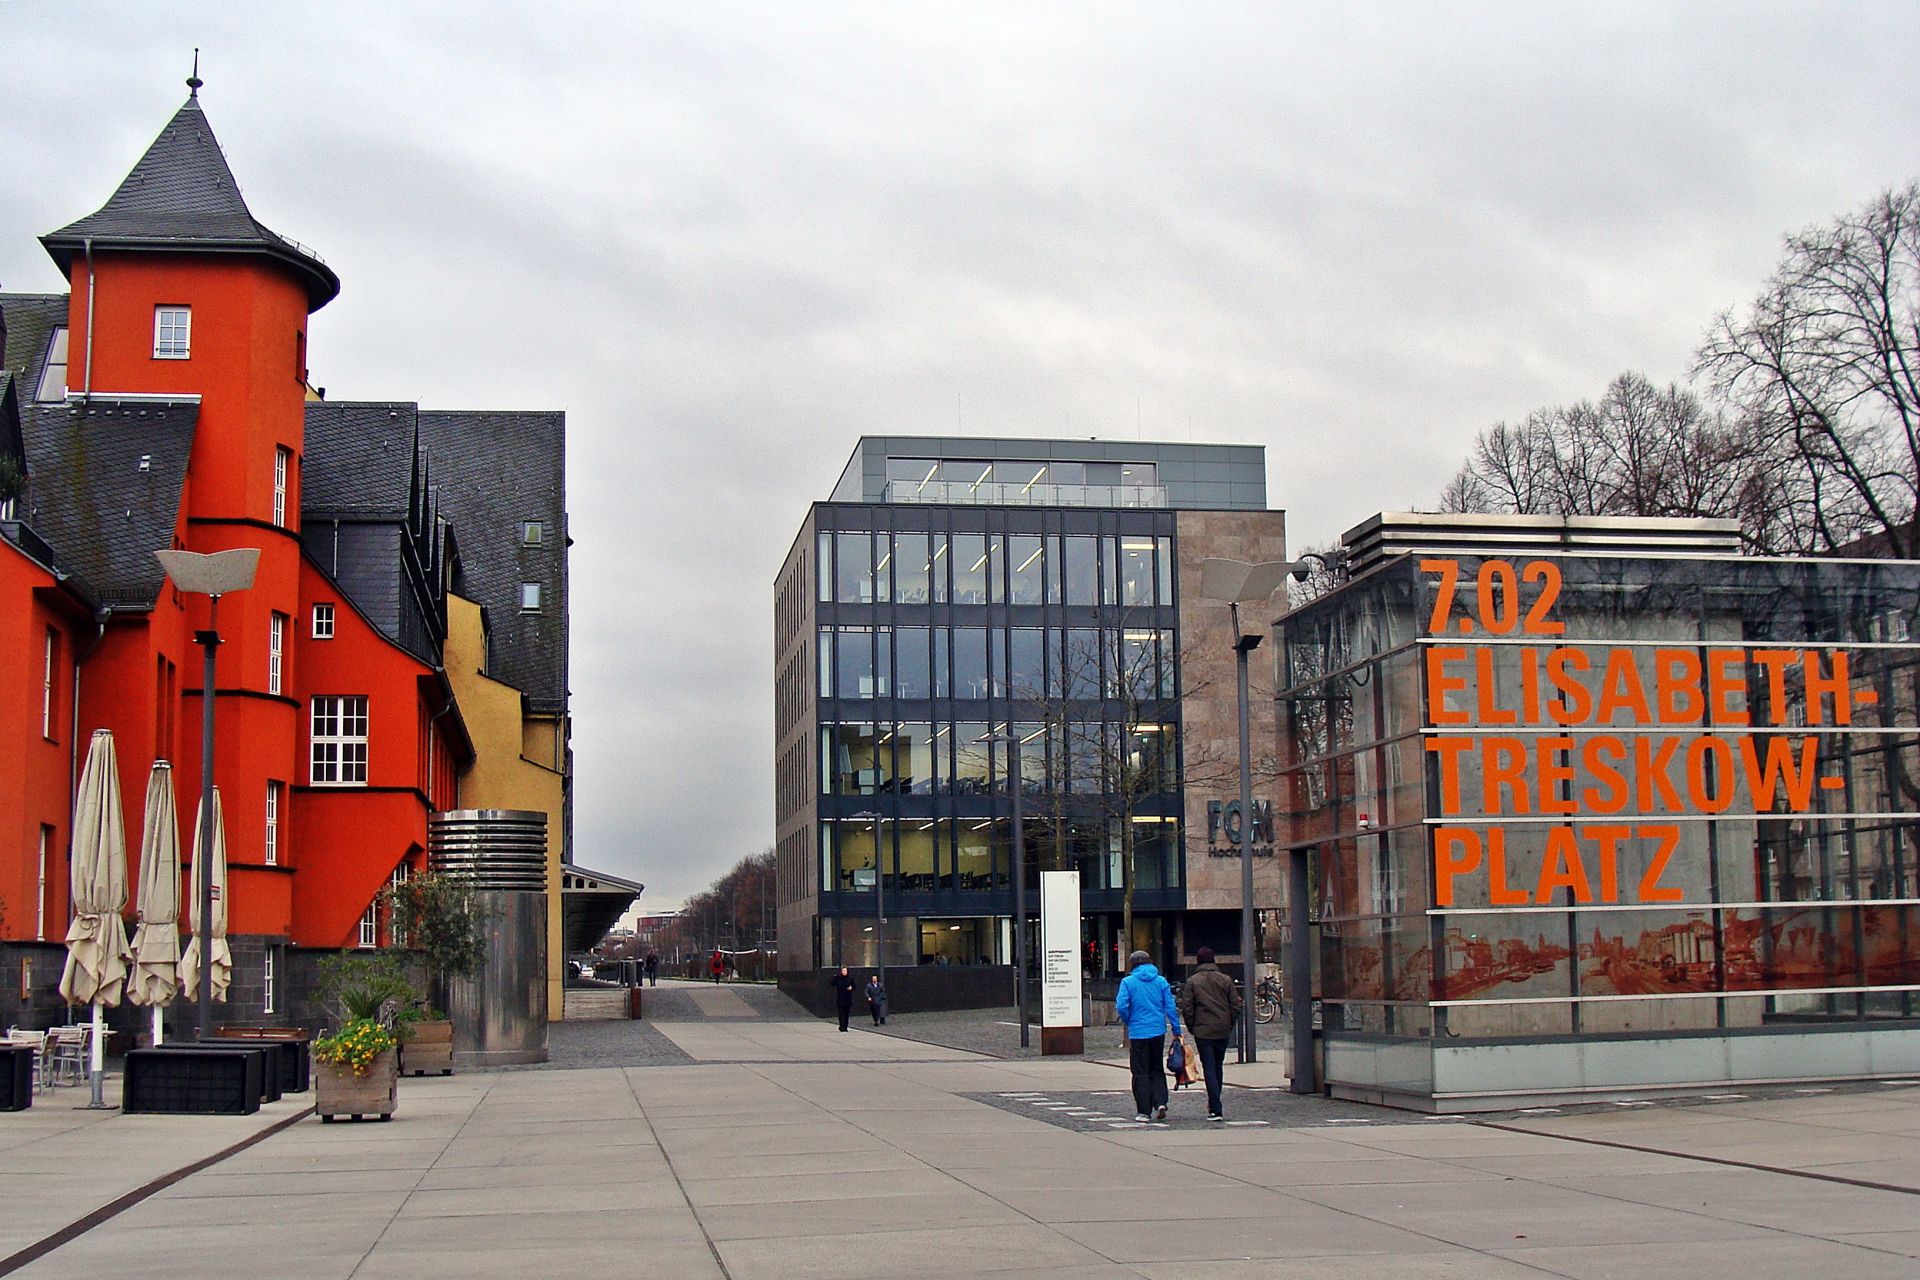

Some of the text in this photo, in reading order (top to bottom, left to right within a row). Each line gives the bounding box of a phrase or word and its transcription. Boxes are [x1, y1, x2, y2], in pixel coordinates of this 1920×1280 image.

[1419, 559, 1565, 635] 7.02
[1426, 647, 1878, 726] ELISABETH-
[1424, 736, 1844, 815] TRESKOW-
[1433, 825, 1683, 907] PLATZ
